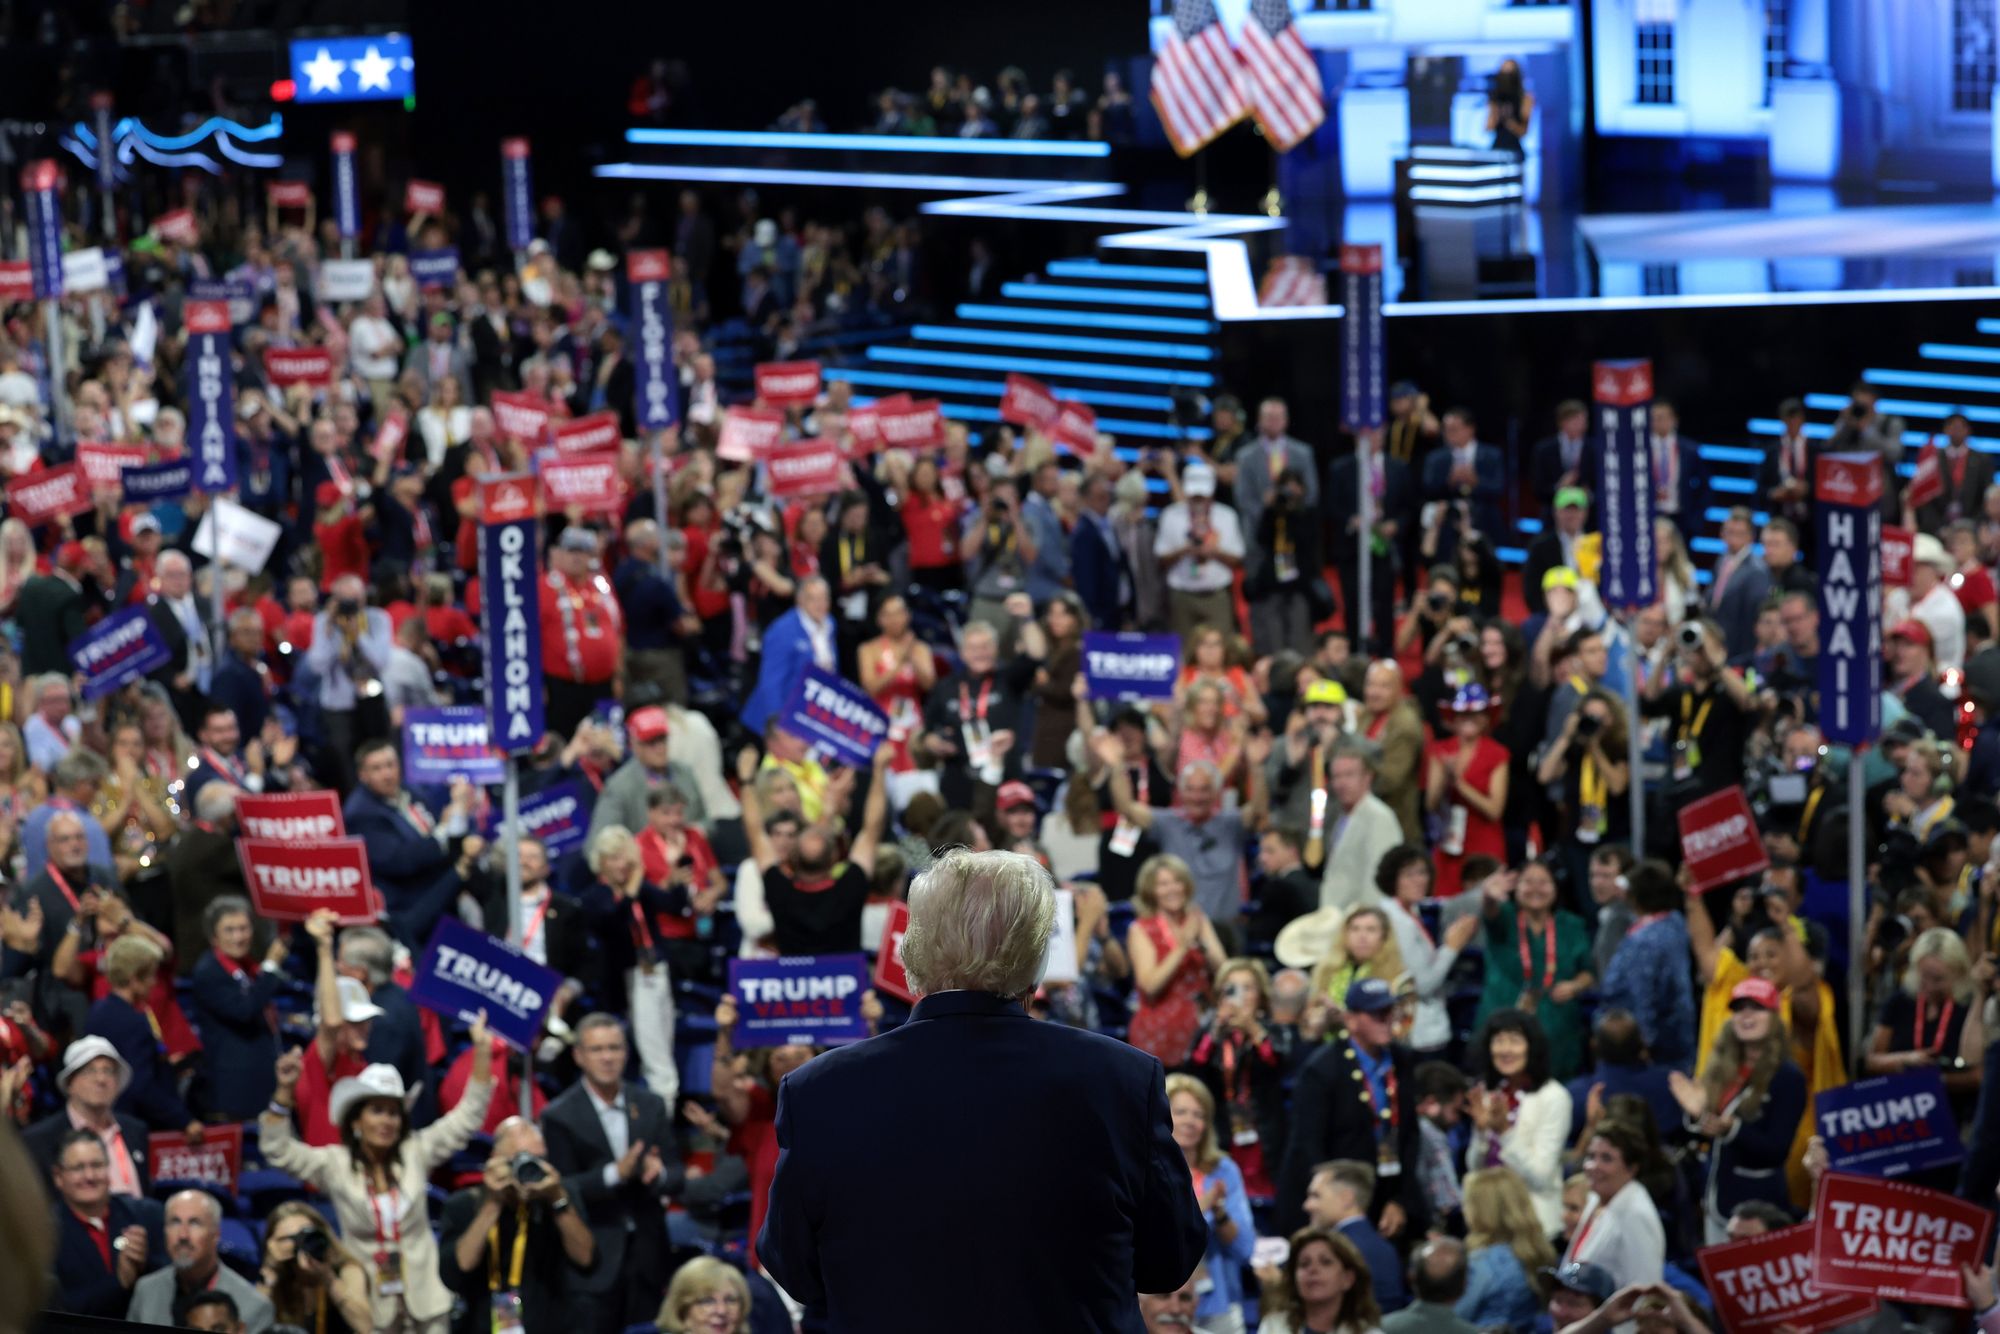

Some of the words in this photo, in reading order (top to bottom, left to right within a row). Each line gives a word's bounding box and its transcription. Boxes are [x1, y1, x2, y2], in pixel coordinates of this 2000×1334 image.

[641, 281, 670, 424] FLORIDA
[198, 333, 226, 485] INDIANA
[1602, 407, 1625, 597] MINNESOTA
[1631, 405, 1652, 597] MINNESOTA
[499, 525, 531, 740] OKLAHOMA
[1823, 510, 1859, 730] HAWAII
[74, 616, 148, 669] TRUMP
[1086, 651, 1175, 676] TRUMP
[803, 678, 886, 735] TRUMP
[410, 723, 489, 746] TRUM
[245, 814, 336, 842] TRUMP
[1682, 813, 1748, 856] TRUMP
[254, 863, 361, 891] TRUMP
[437, 944, 543, 1012] TRUMP
[738, 974, 858, 1003] TRUMP
[753, 1001, 844, 1019] VANCE
[1821, 1091, 1937, 1138] TRUMP
[1838, 1119, 1931, 1154] VANCE
[1829, 1200, 1976, 1244] TRUMP
[1840, 1230, 1956, 1266] VANCE
[1736, 1280, 1824, 1316] VANC
